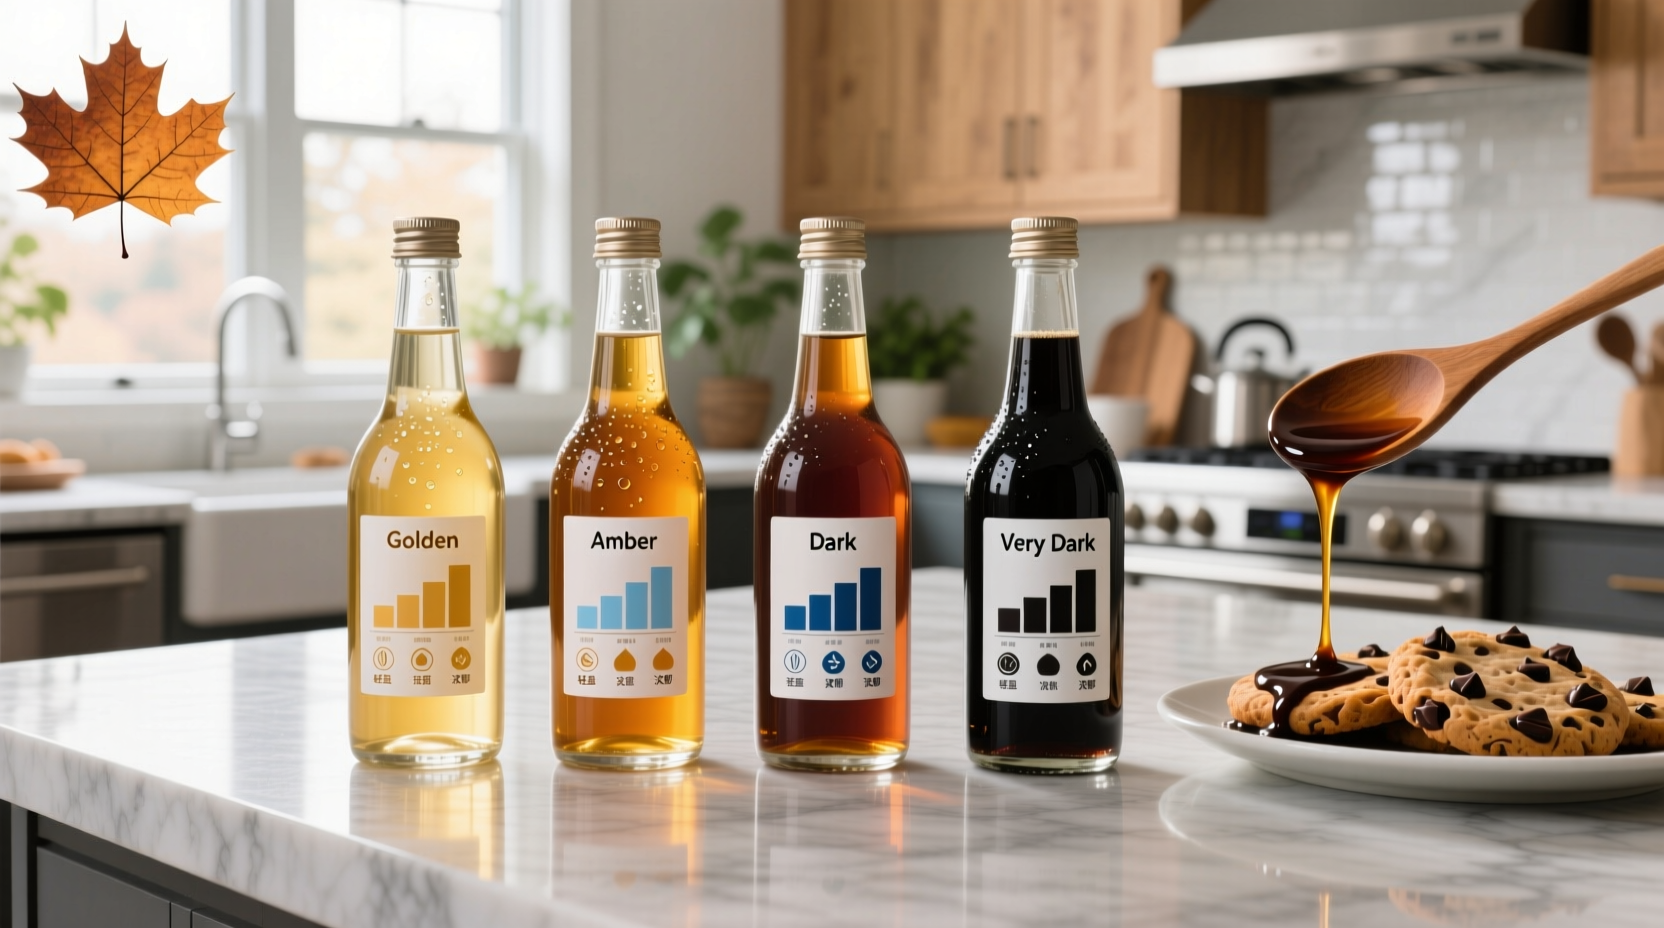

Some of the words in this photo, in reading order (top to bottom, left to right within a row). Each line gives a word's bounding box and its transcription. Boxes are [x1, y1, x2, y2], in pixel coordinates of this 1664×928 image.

[386, 530, 459, 549] Golden
[590, 531, 658, 550] Amber
[810, 532, 857, 551] Dark
[1000, 532, 1046, 558] Very
[1051, 532, 1096, 552] Dark
